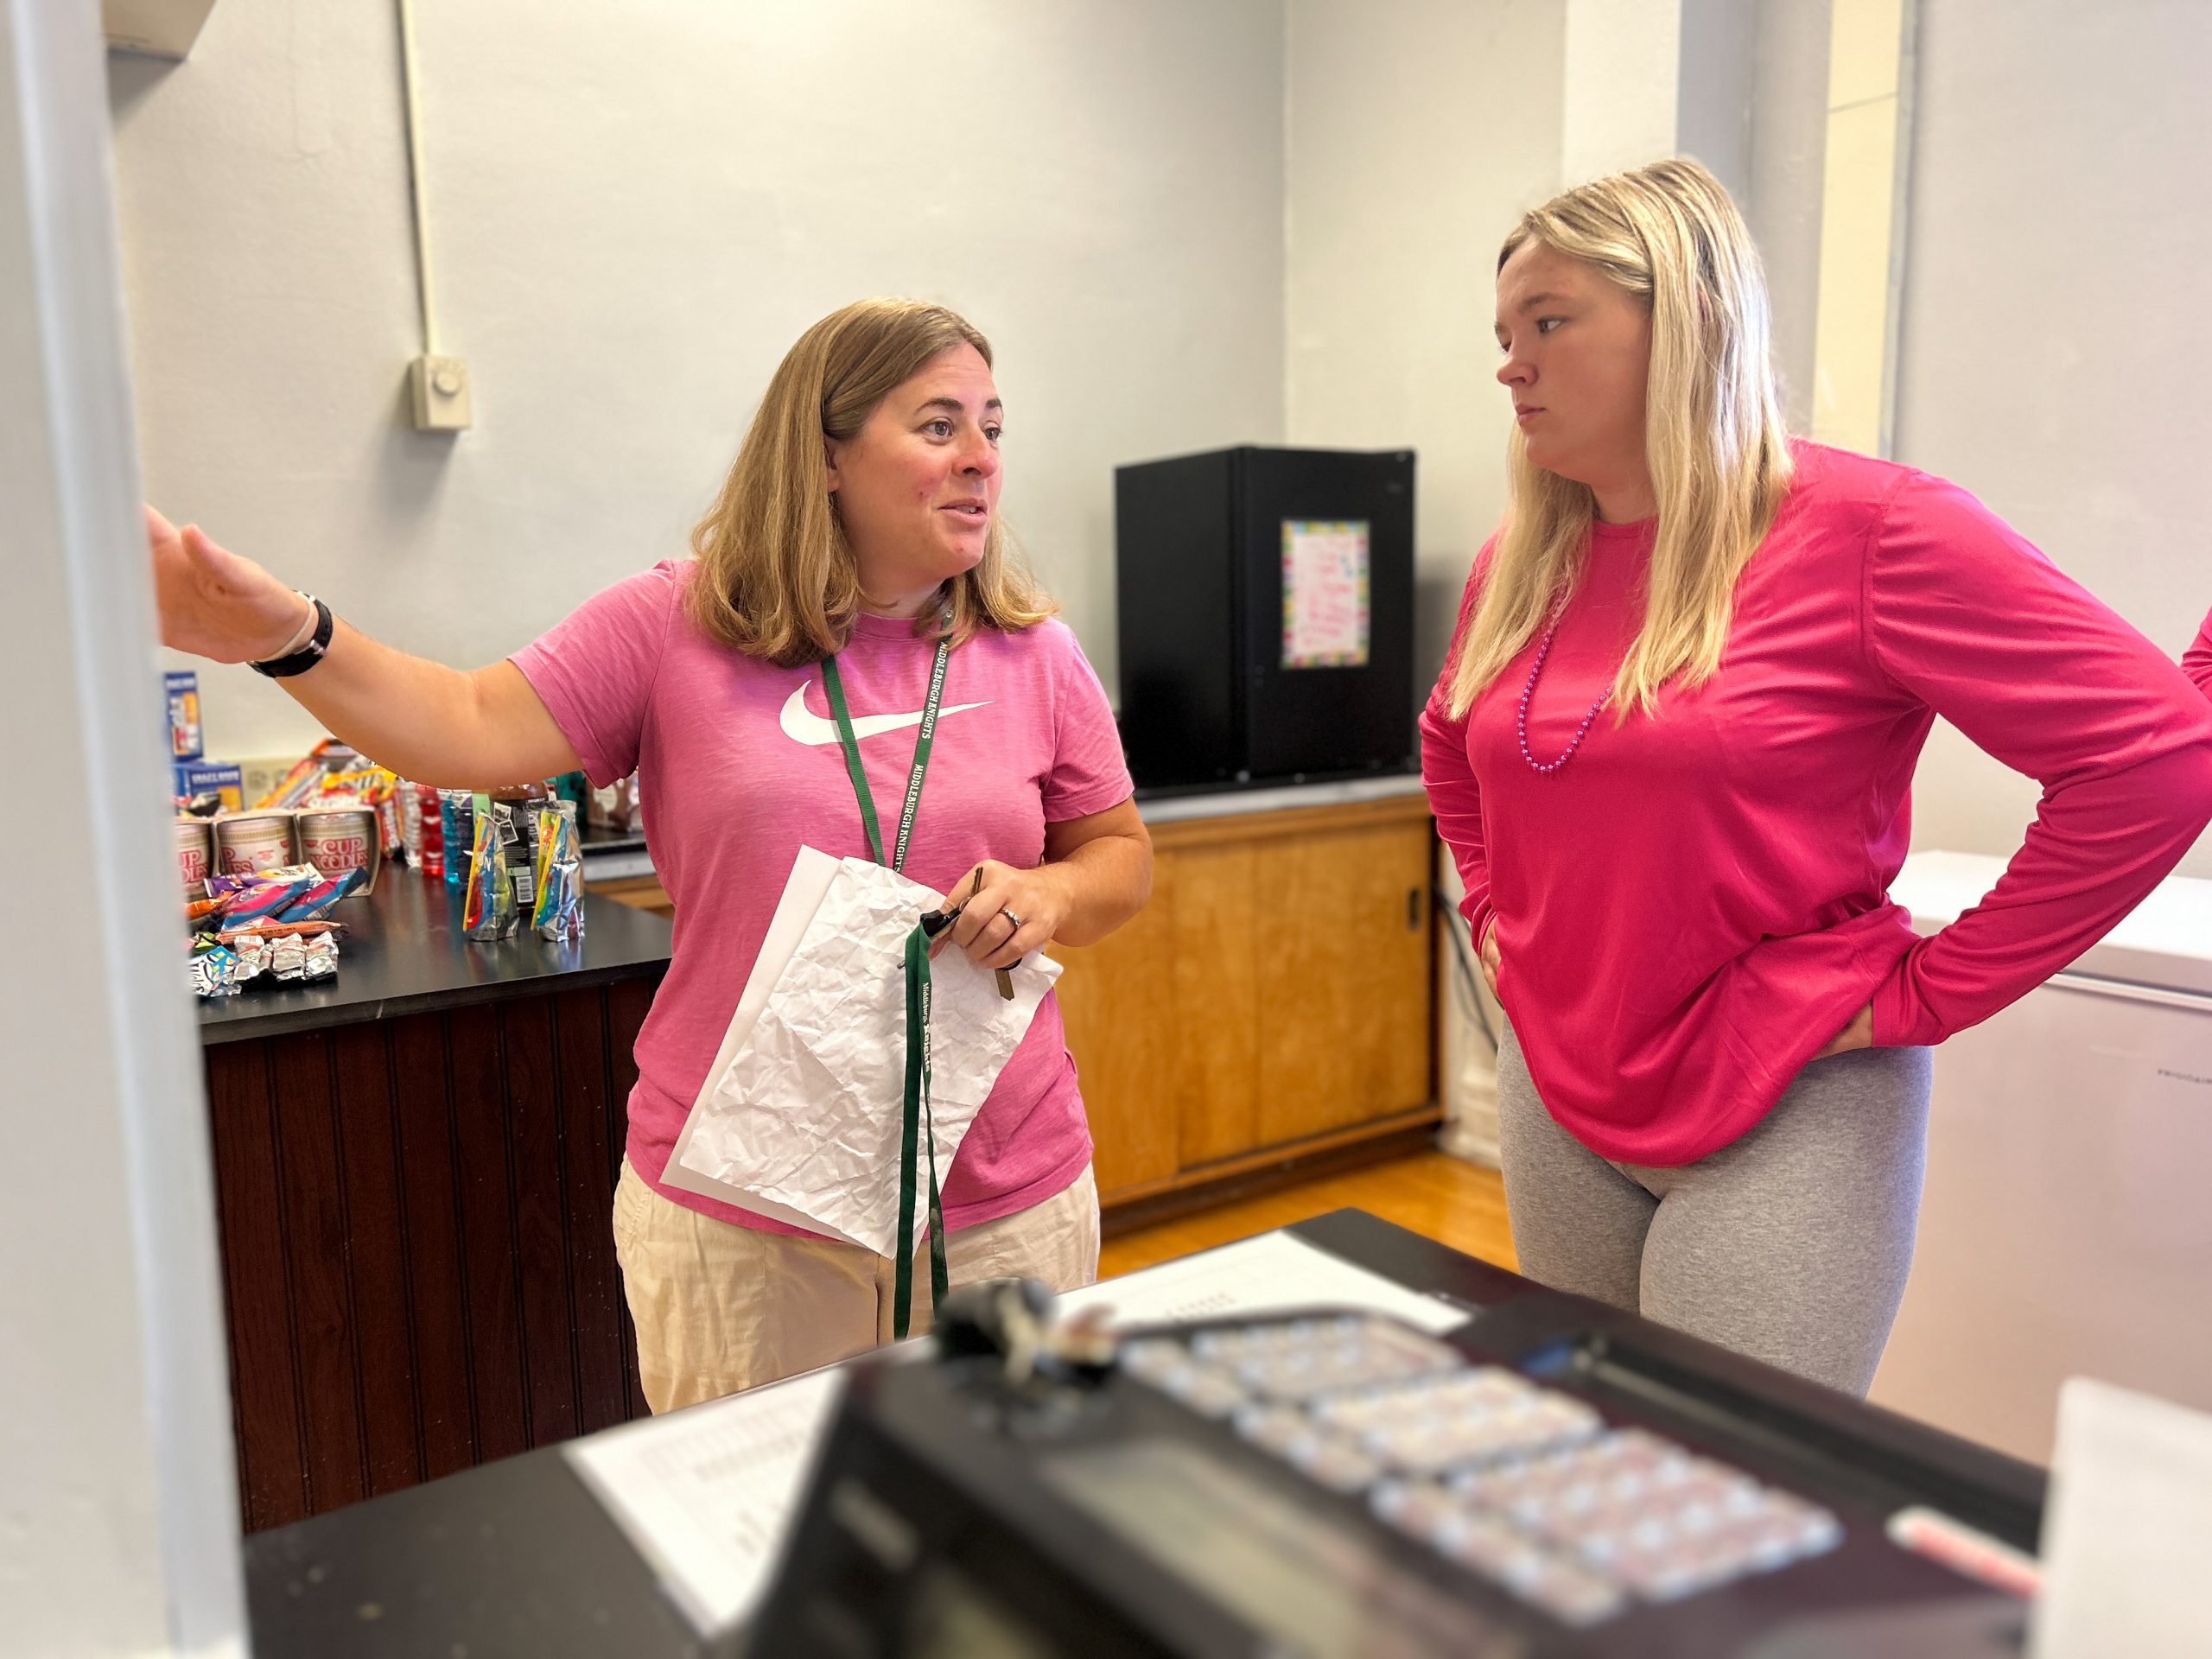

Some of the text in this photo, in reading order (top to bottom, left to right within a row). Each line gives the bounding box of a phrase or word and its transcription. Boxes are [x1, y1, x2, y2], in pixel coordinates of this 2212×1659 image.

[921, 641, 948, 739] MIDDLEBURGH KNIGHTS
[321, 837, 363, 855] CUP
[894, 763, 924, 873] MIDDLEBURGH KNIGHTS
